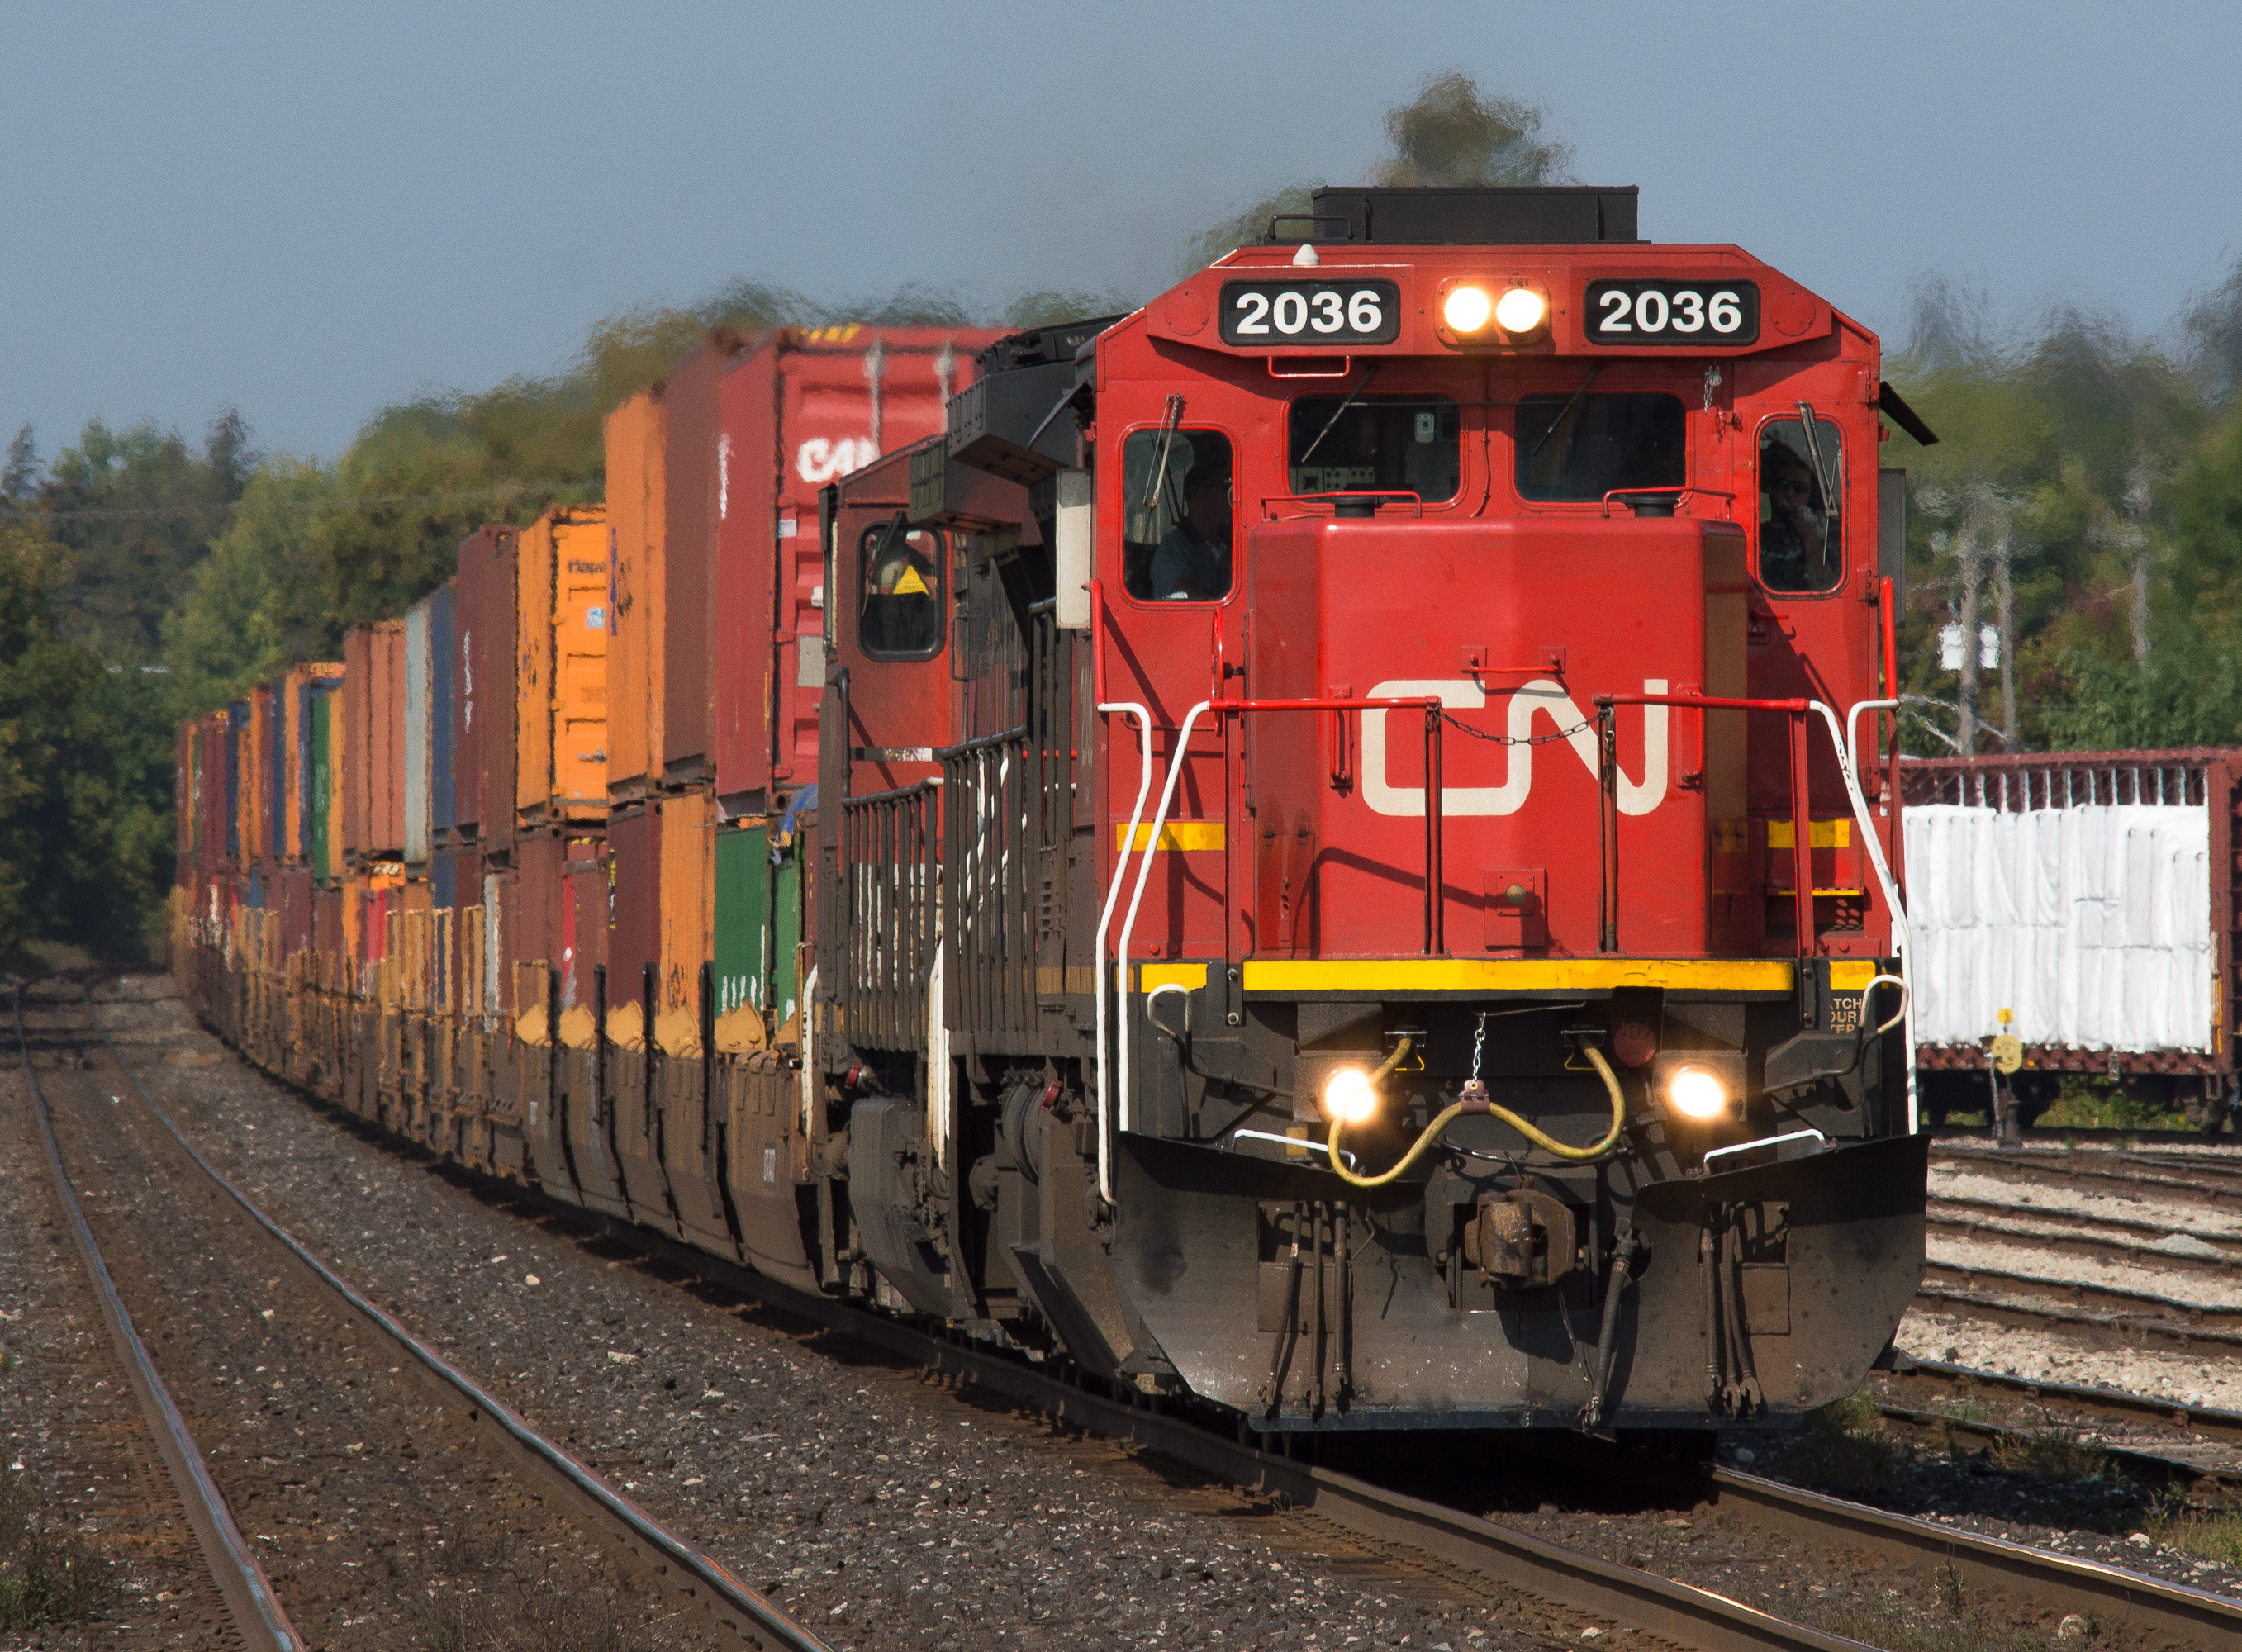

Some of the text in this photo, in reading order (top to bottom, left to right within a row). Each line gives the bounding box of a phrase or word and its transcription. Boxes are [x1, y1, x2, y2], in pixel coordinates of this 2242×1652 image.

[1237, 290, 1382, 334] 2036
[1599, 290, 1742, 333] 2036
[1361, 678, 1668, 816] CN
[1830, 997, 1862, 1009] TCH
